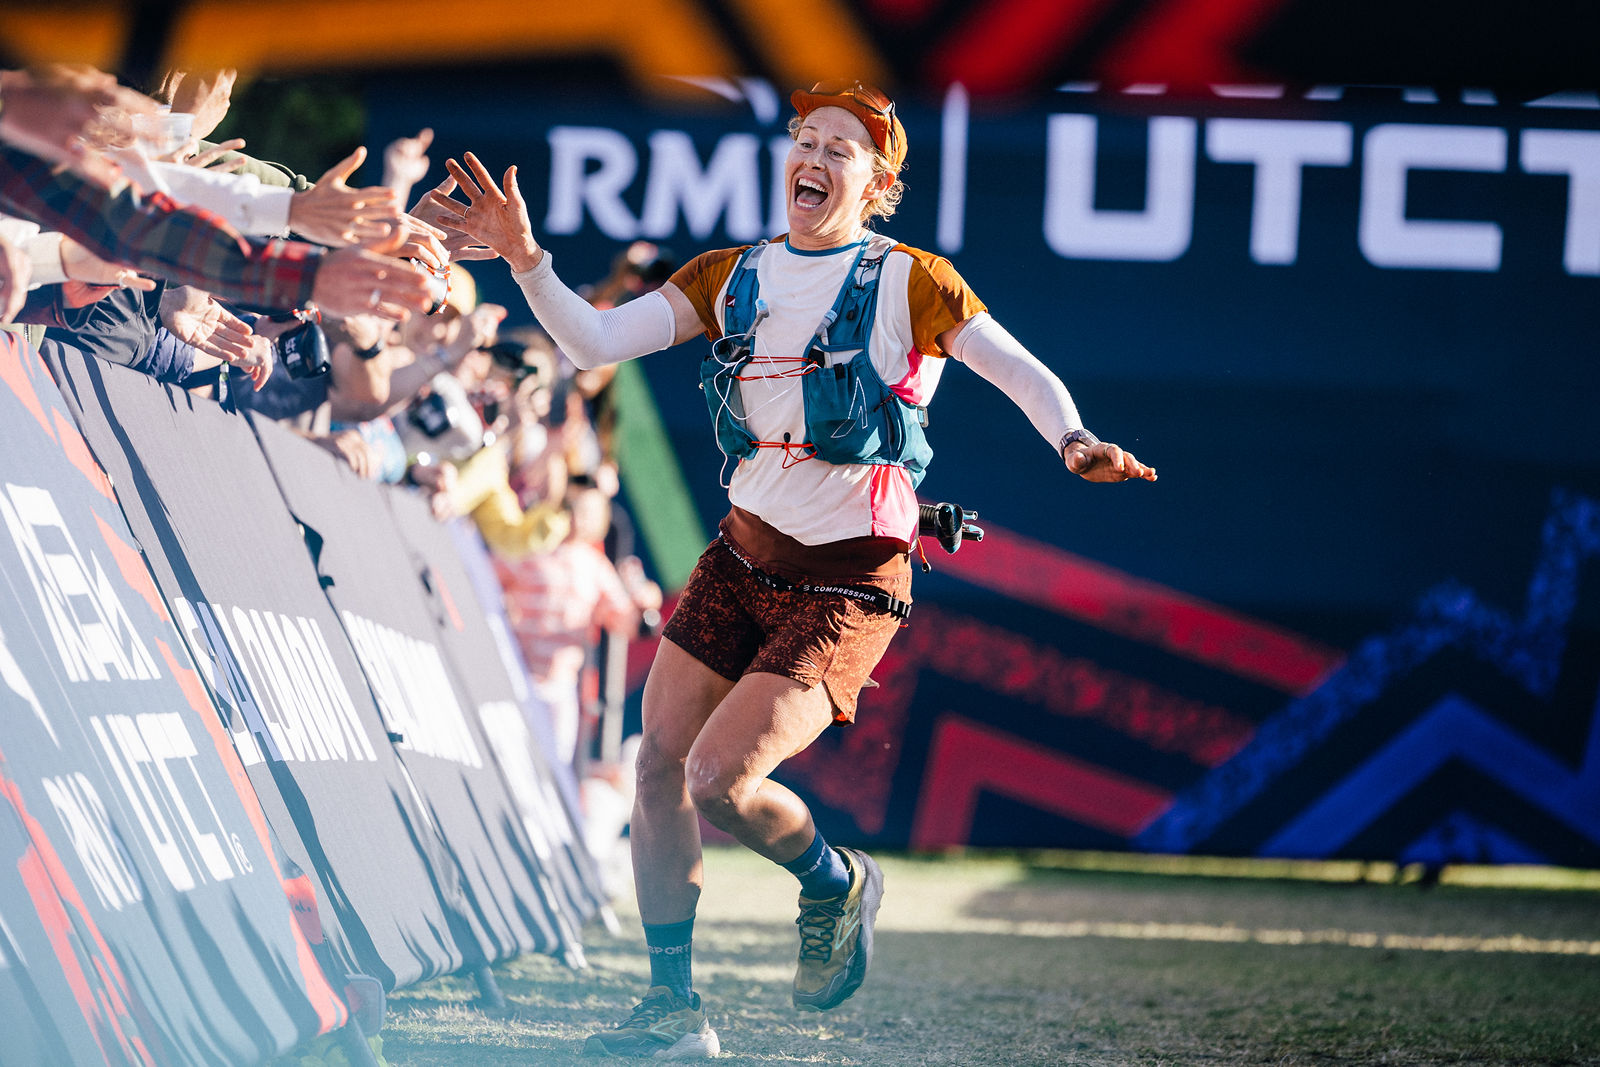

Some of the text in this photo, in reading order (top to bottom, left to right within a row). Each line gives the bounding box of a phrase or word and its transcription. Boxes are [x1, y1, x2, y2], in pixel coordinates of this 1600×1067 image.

[1043, 112, 1600, 277] UTCT
[174, 596, 378, 767] SALOMON
[89, 711, 237, 892] UTCT
